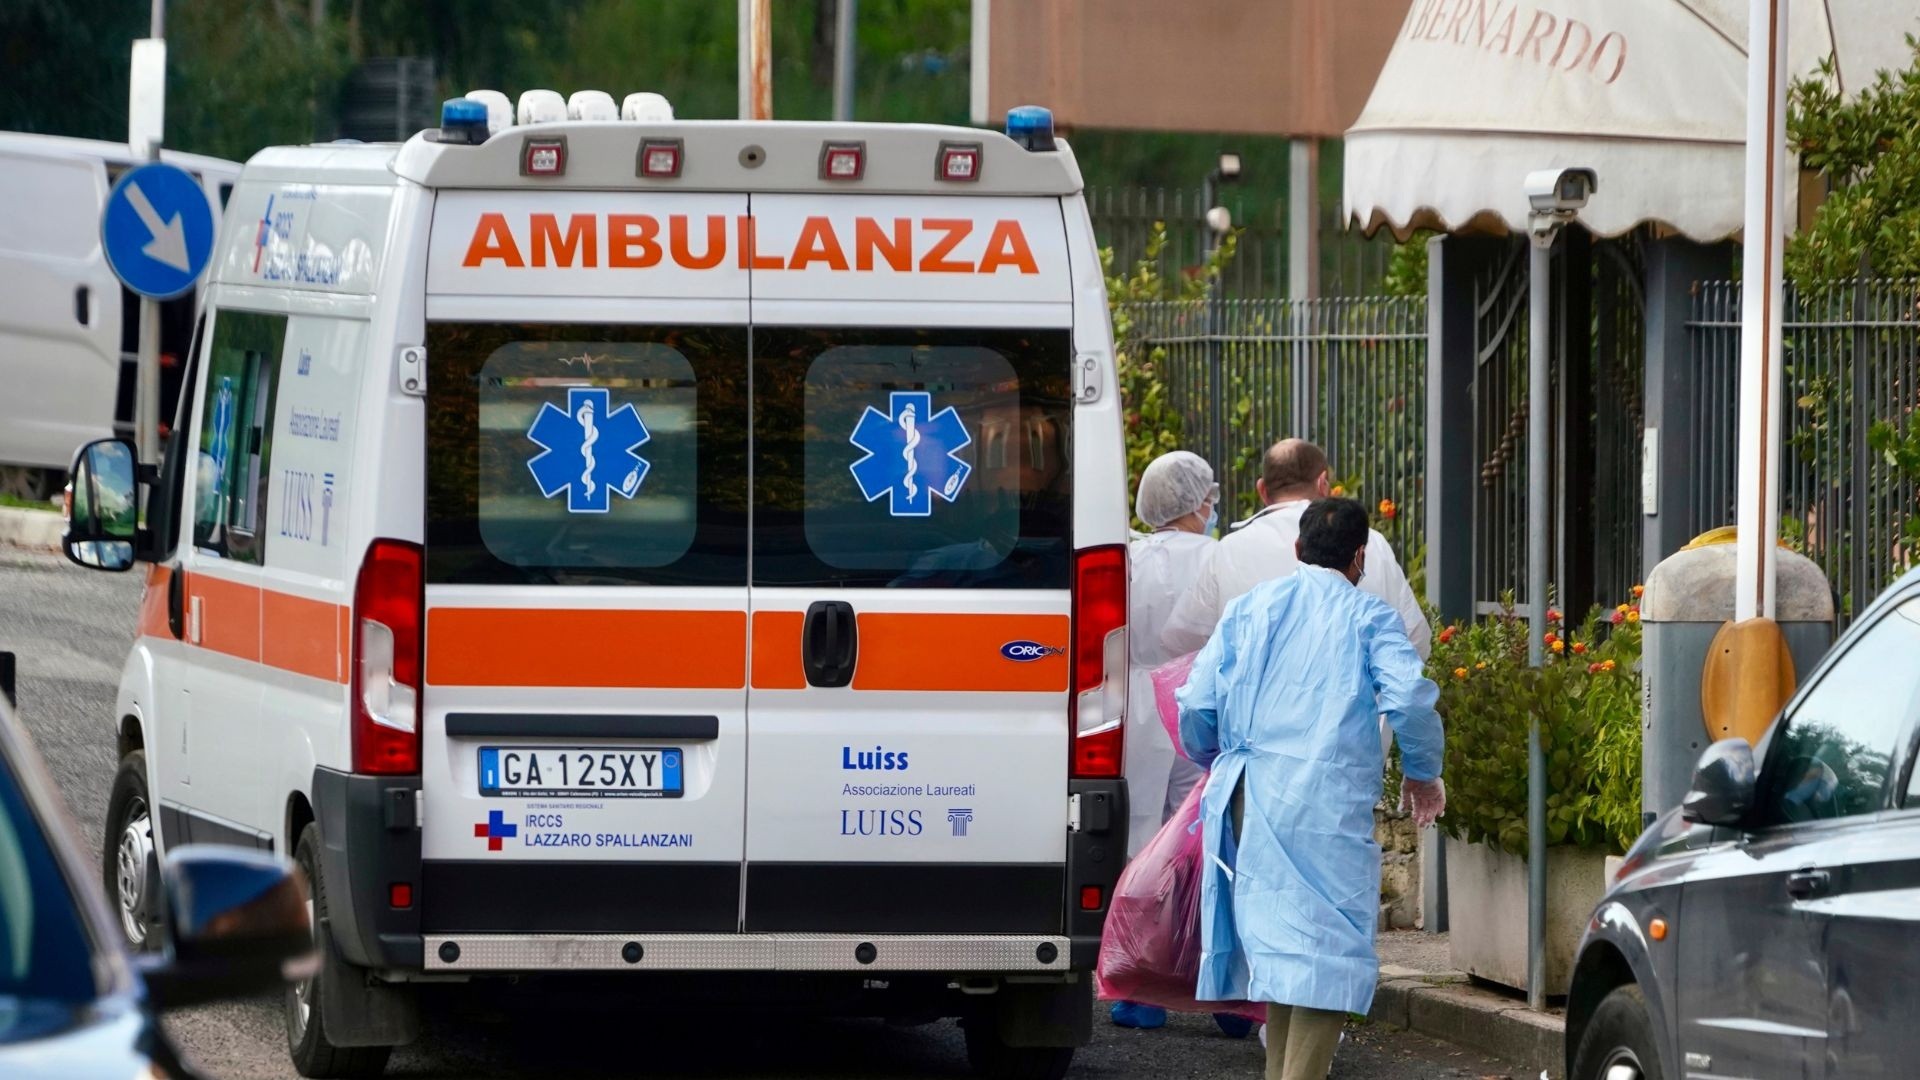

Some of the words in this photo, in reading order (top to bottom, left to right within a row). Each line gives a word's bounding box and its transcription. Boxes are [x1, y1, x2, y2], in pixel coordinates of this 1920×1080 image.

[1411, 0, 1628, 85] BERNARDO
[462, 212, 1040, 275] AMBULANZA
[843, 746, 908, 771] Luiss
[842, 783, 923, 796] Associazione
[927, 784, 976, 796] Laureati
[525, 814, 563, 828] IRCCS
[840, 809, 924, 837] LUISS
[525, 833, 592, 847] LAZZARO
[595, 833, 693, 848] SPALLANZANI
